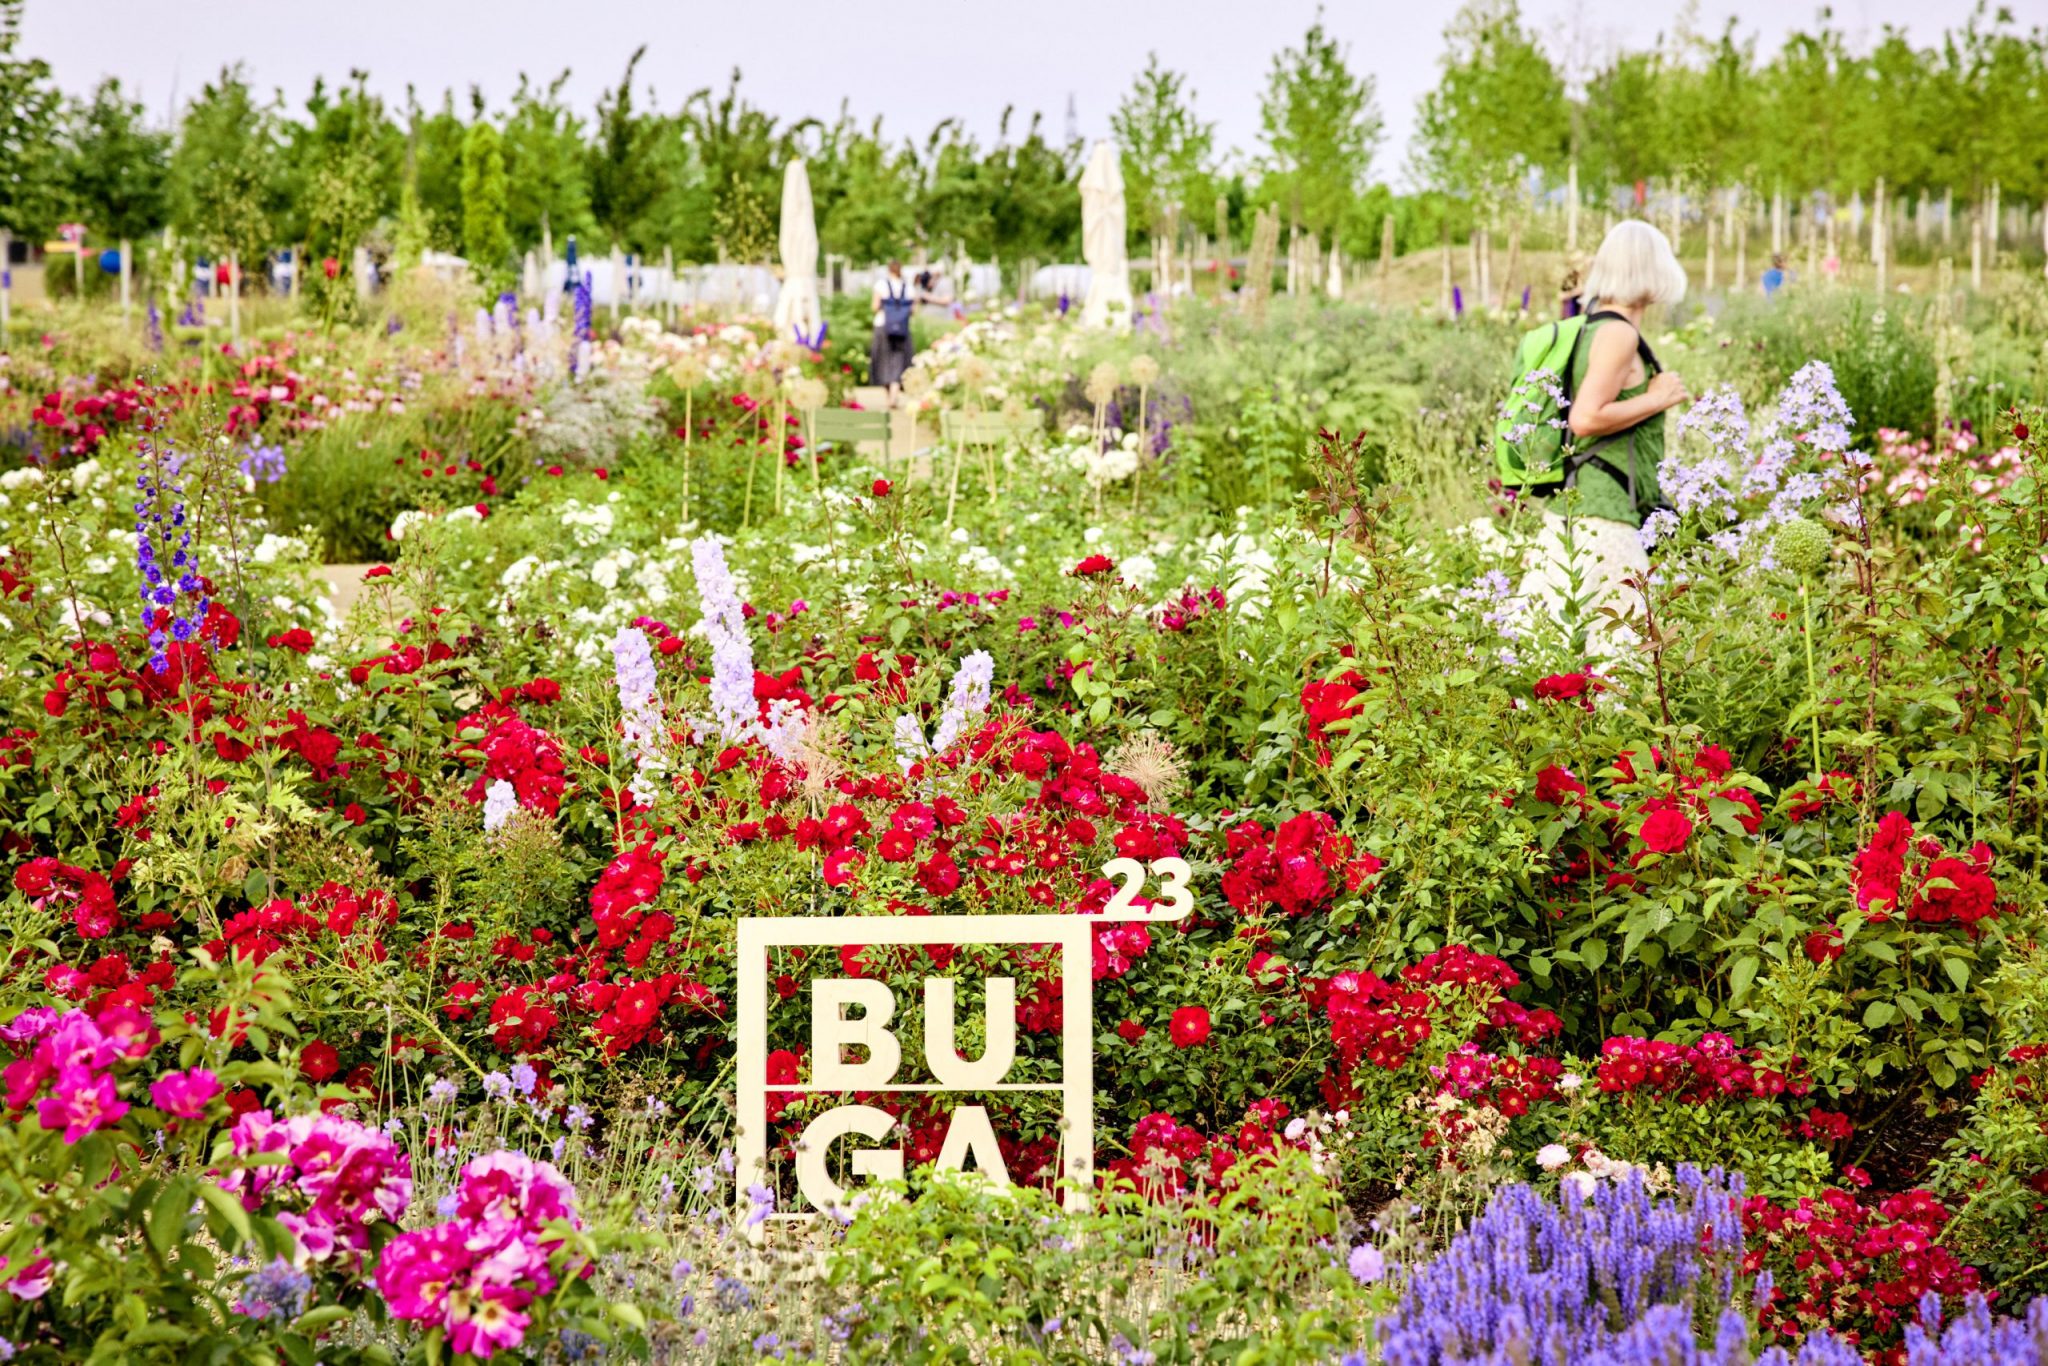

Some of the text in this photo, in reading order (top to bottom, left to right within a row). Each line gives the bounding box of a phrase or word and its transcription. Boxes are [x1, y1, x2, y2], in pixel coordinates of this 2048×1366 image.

[1100, 857, 1195, 922] 23
[811, 977, 1017, 1089] BU
[795, 1104, 1012, 1216] GA
